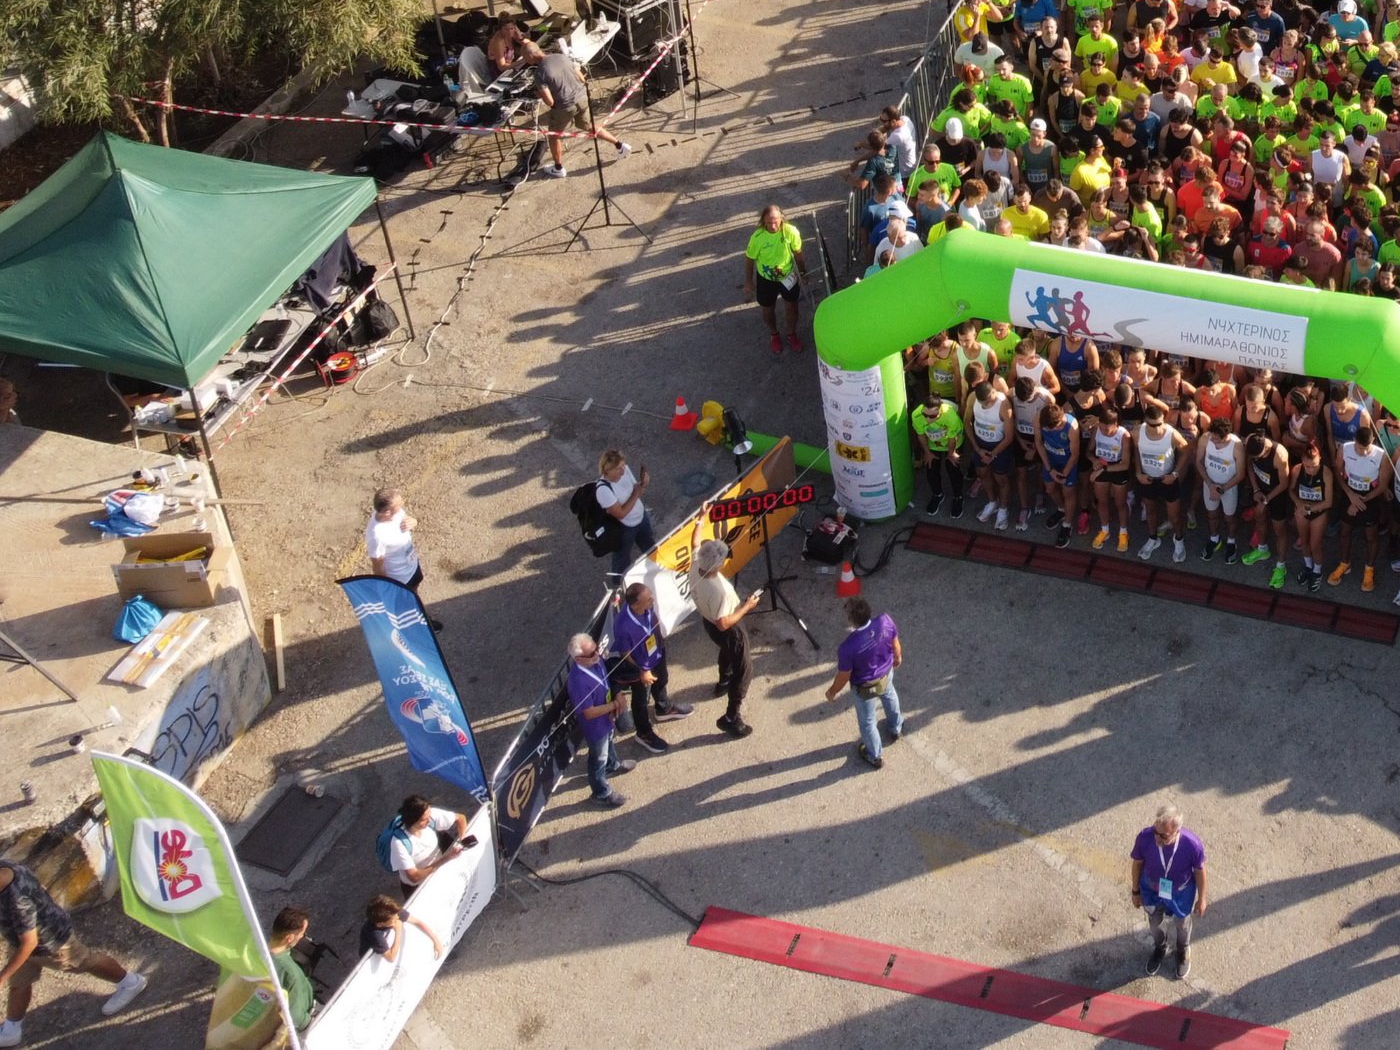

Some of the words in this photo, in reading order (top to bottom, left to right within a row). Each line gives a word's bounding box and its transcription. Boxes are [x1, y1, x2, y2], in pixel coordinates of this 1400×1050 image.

[1180, 332, 1289, 360] ΗΜΙΜΑΡΑΘΩΝΙΟΣ
[977, 430, 995, 439] 6250
[1349, 479, 1369, 491] 5653
[1300, 489, 1320, 499] 5379
